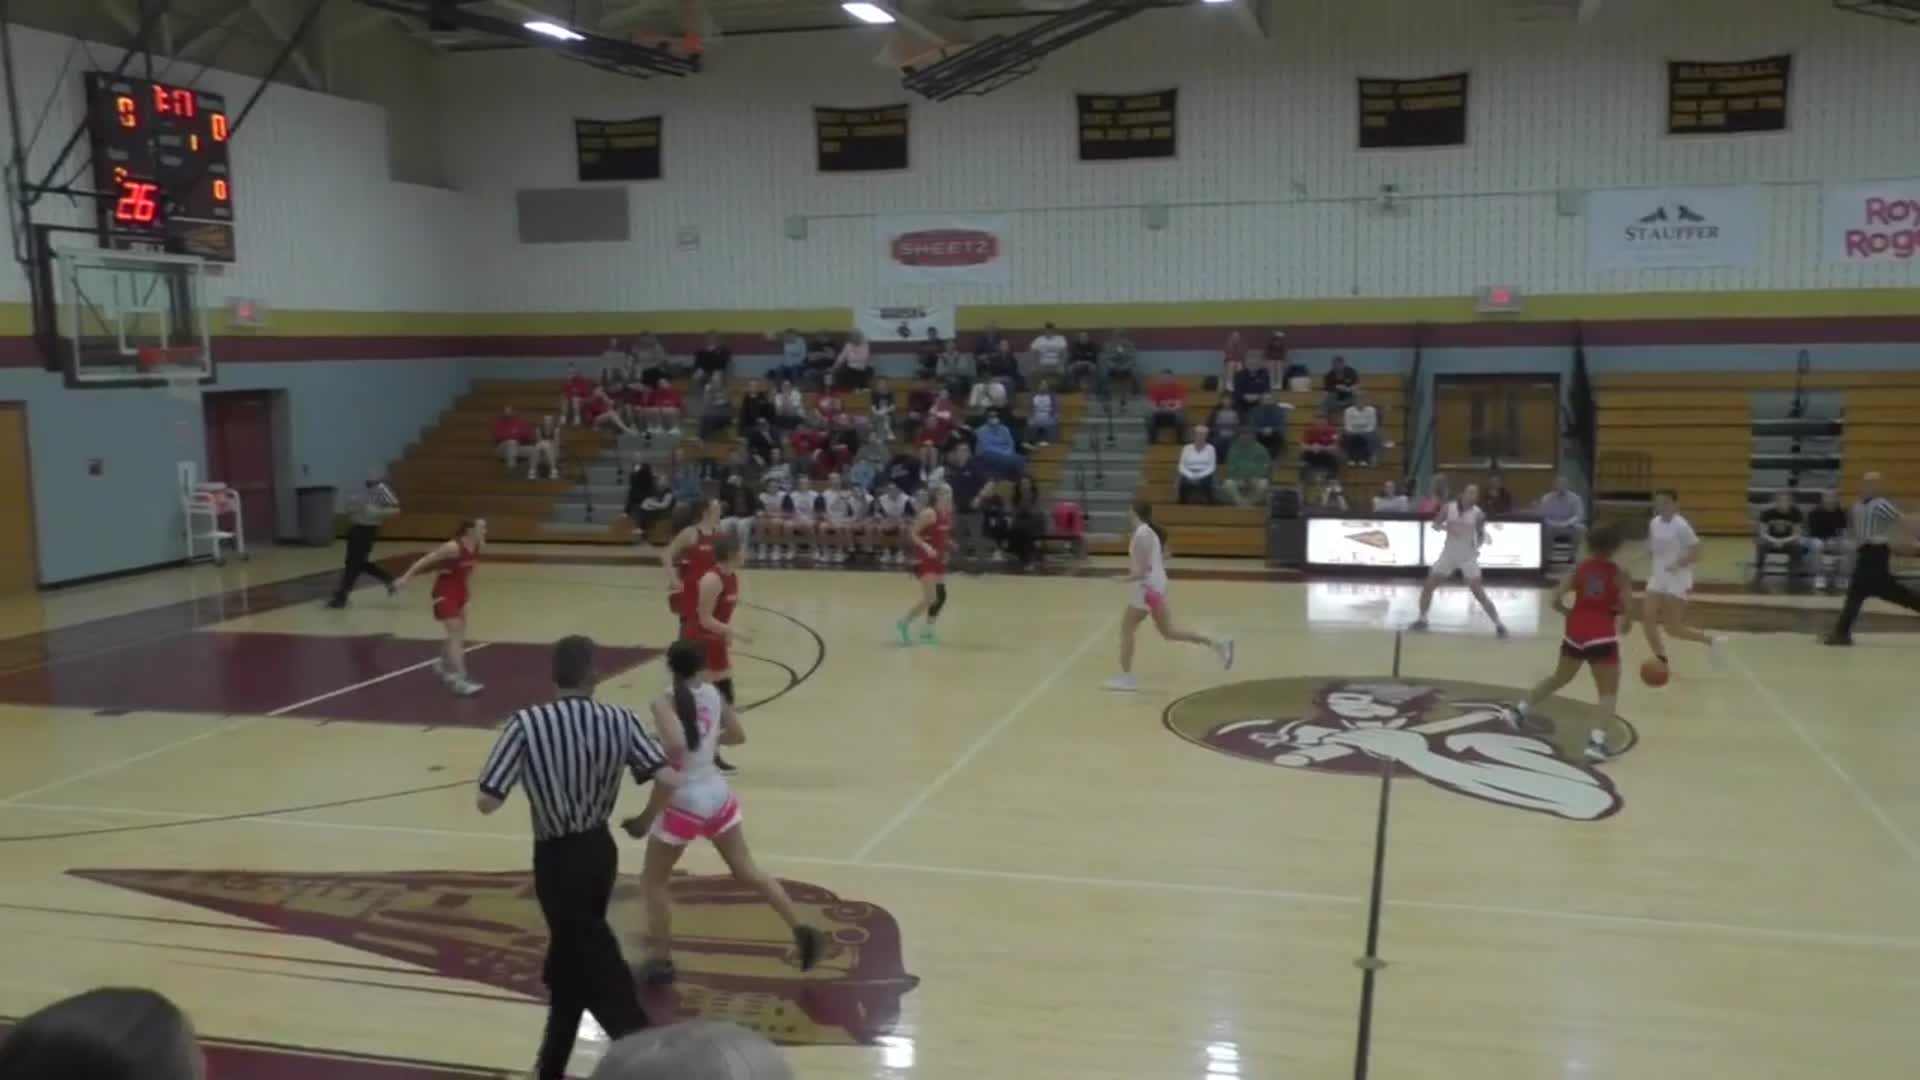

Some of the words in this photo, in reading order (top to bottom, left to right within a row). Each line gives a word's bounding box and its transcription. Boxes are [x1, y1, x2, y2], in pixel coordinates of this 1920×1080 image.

[211, 113, 228, 141] 0
[190, 133, 198, 151] 1
[214, 179, 228, 200] 0
[115, 182, 157, 220] 26
[1624, 226, 1720, 241] STAUFFER
[900, 240, 988, 257] SHEETZ
